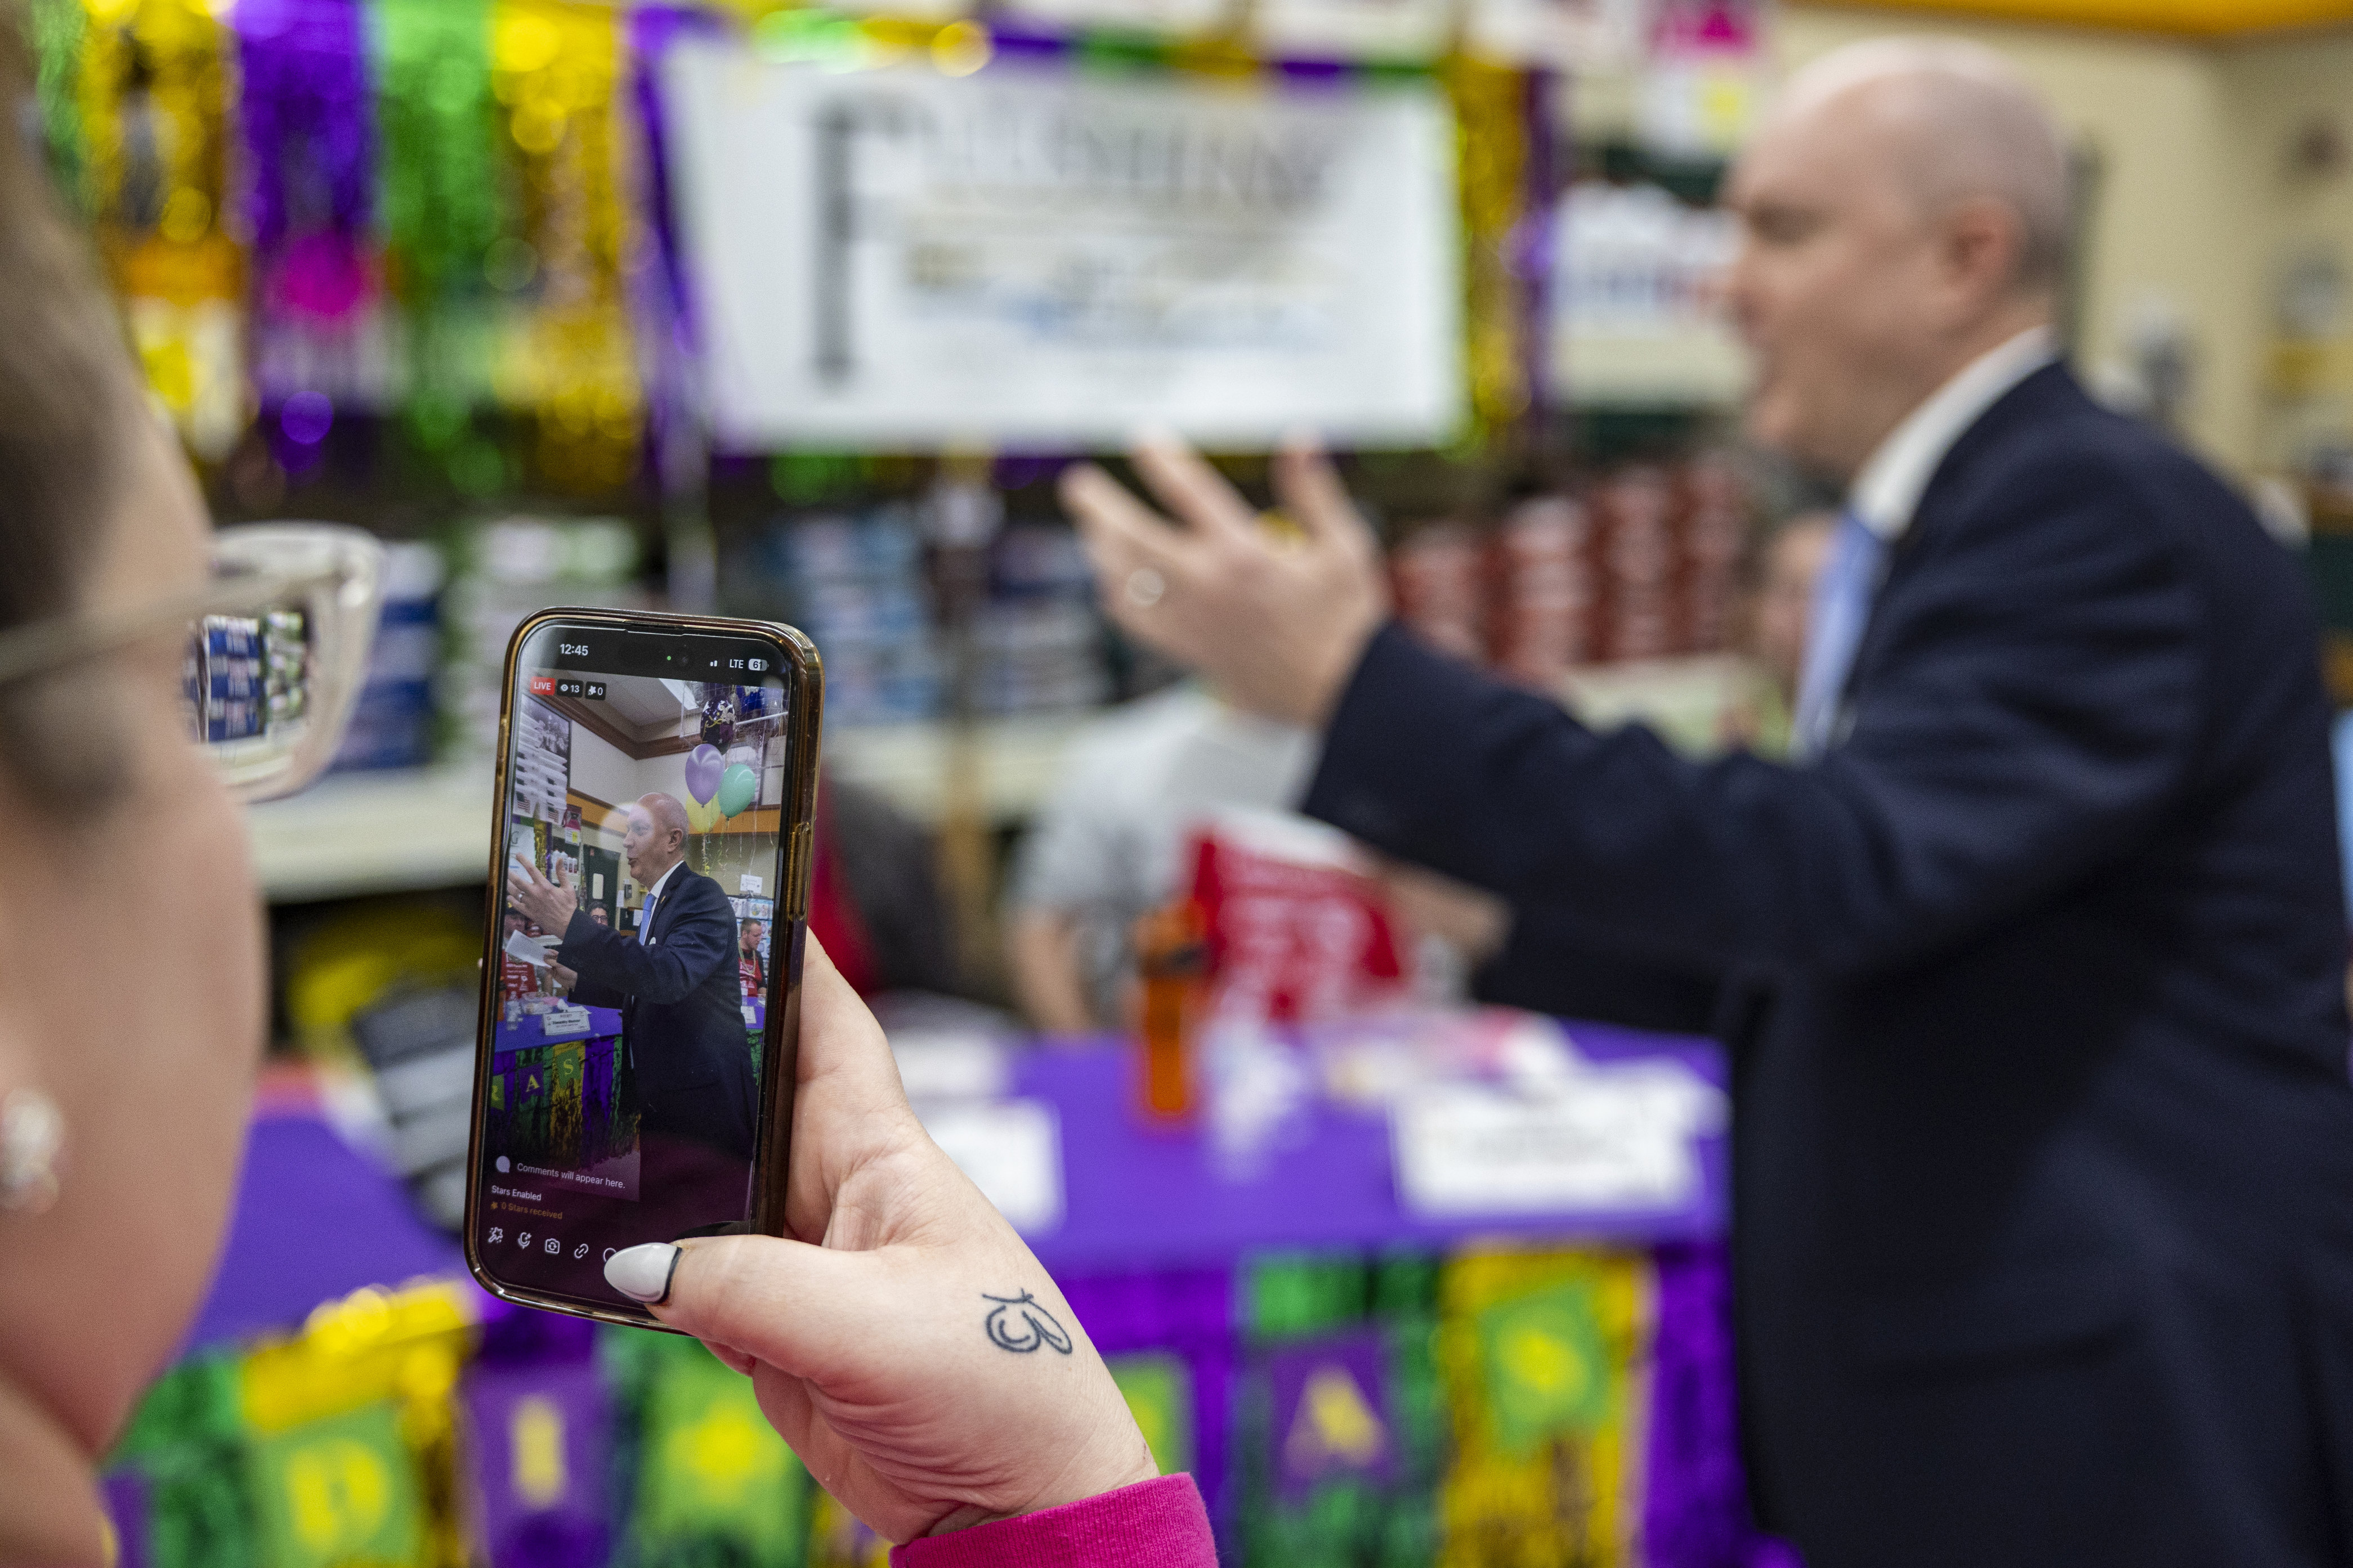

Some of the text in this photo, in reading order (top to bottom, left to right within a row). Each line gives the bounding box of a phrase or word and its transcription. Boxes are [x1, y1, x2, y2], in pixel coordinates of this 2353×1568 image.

[560, 643, 589, 656] 12:45
[729, 658, 744, 669] LTE
[534, 682, 551, 691] LIVE
[517, 1162, 626, 1189] Comments will appear here.
[491, 1185, 542, 1202] Stars Enabled
[508, 1202, 529, 1213] Stars
[529, 1207, 563, 1220] received
